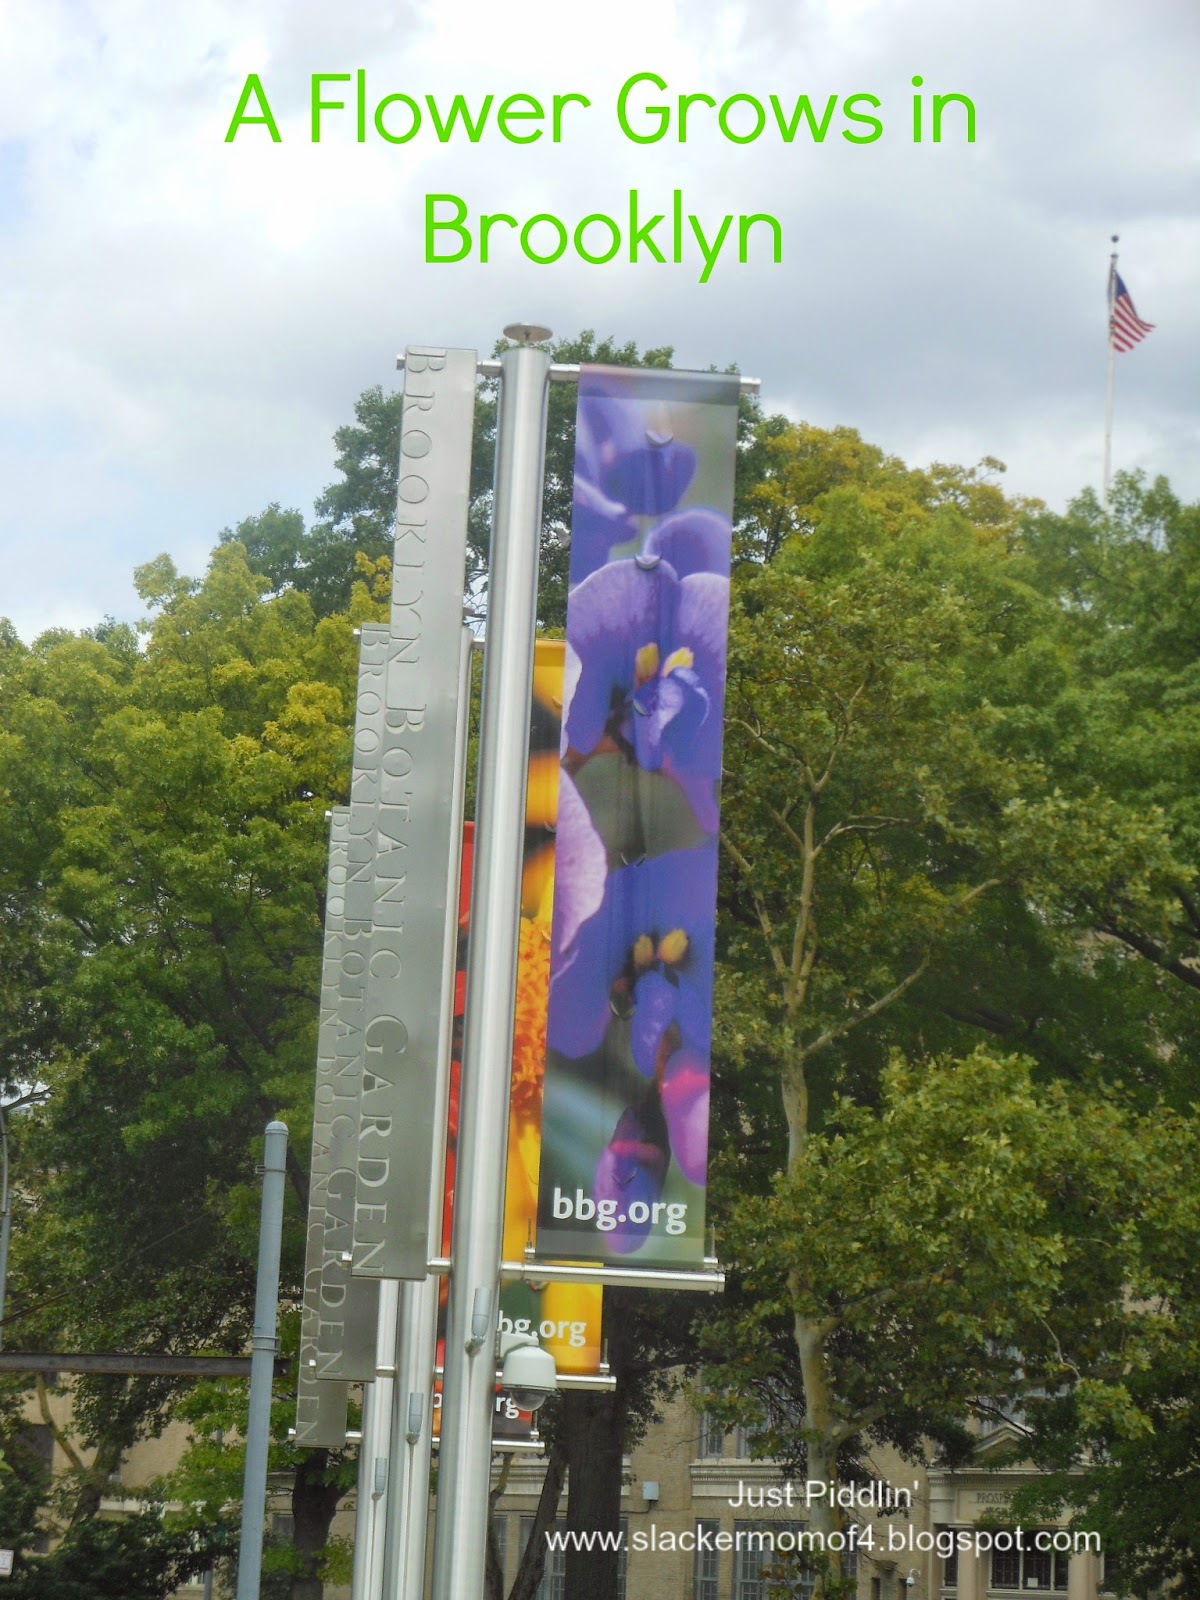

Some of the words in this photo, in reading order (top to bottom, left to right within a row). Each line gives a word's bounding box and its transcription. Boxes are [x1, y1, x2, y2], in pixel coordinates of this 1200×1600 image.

[387, 346, 448, 665] BROOKLYN
[368, 703, 428, 980] BOTANIC
[352, 1014, 409, 1275] GARDEN
[553, 1187, 688, 1235] bbg.org
[498, 1310, 587, 1348] bg.org
